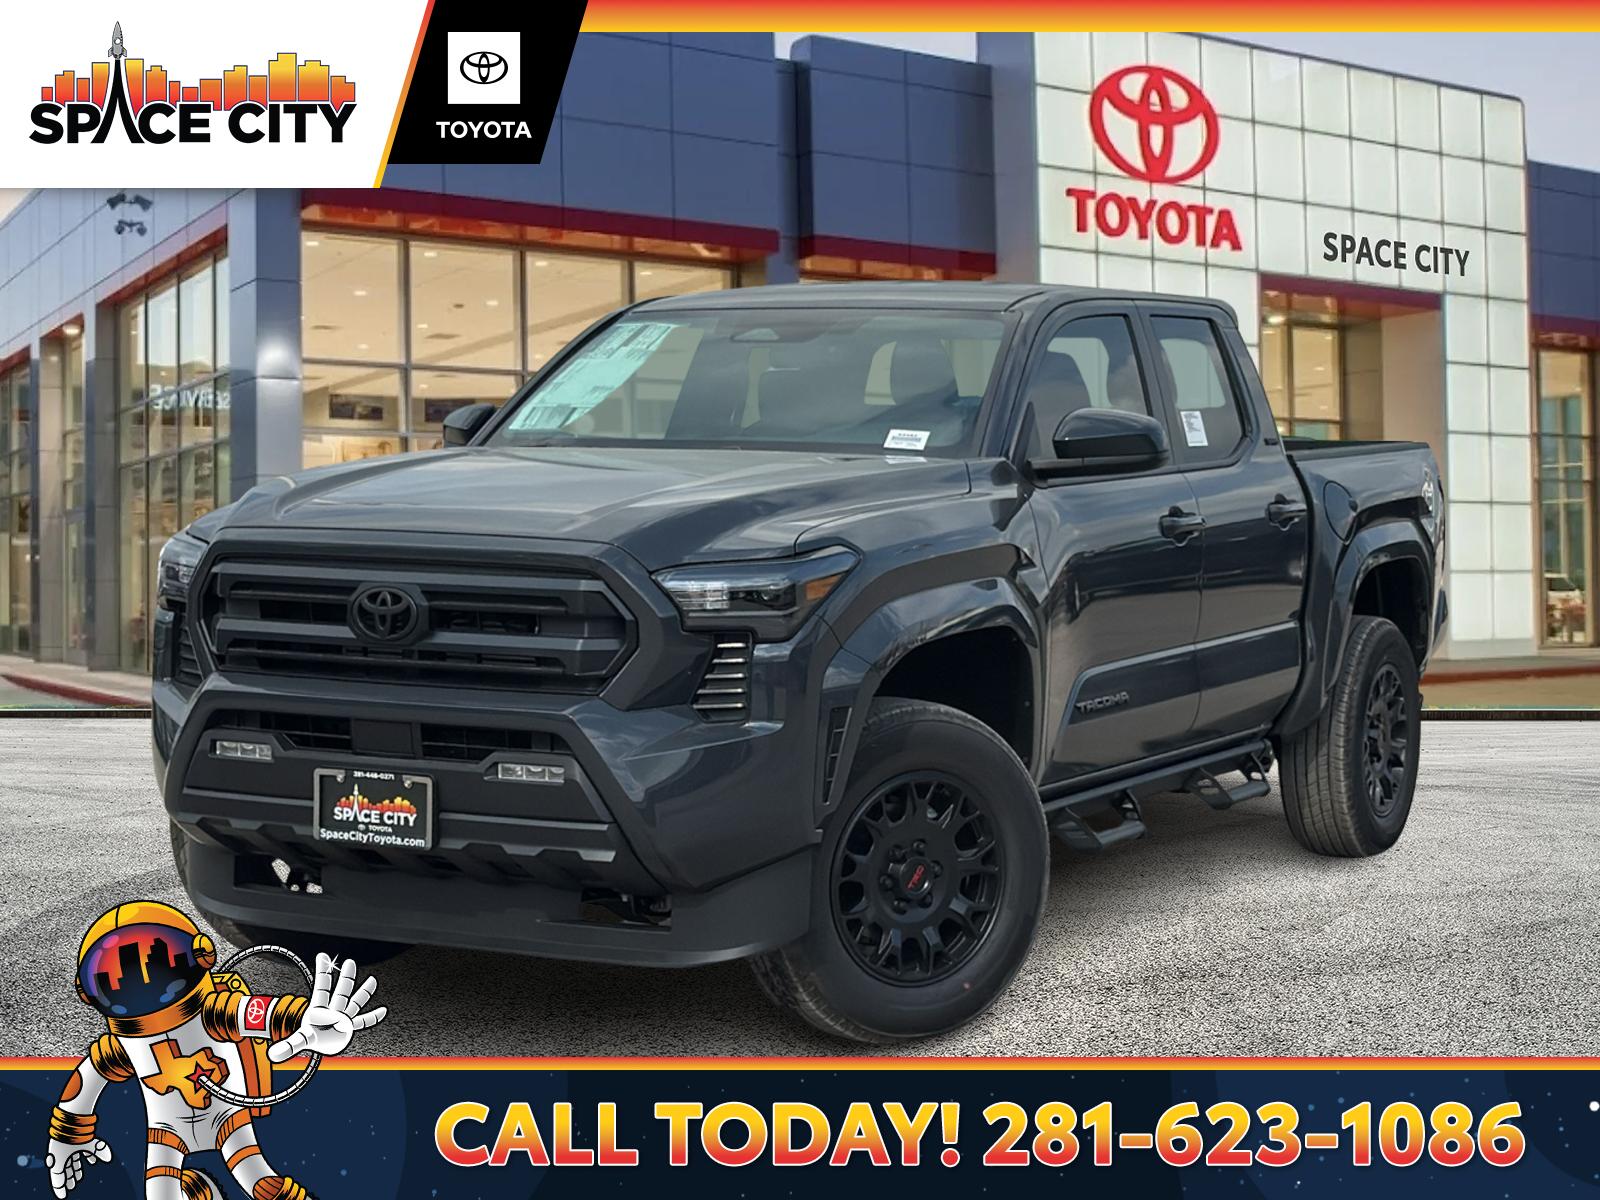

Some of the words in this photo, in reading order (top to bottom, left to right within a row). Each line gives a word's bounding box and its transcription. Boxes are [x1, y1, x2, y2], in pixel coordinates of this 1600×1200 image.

[1066, 187, 1242, 251] TOYOTA
[1323, 231, 1407, 270] SPACE
[1415, 242, 1470, 277] CITY
[1075, 691, 1129, 713] TACOMA
[333, 806, 380, 823] SPACE
[383, 811, 417, 827] CITY
[320, 828, 425, 847] SpaceCityToyota.com
[368, 824, 393, 833] TOYOTA
